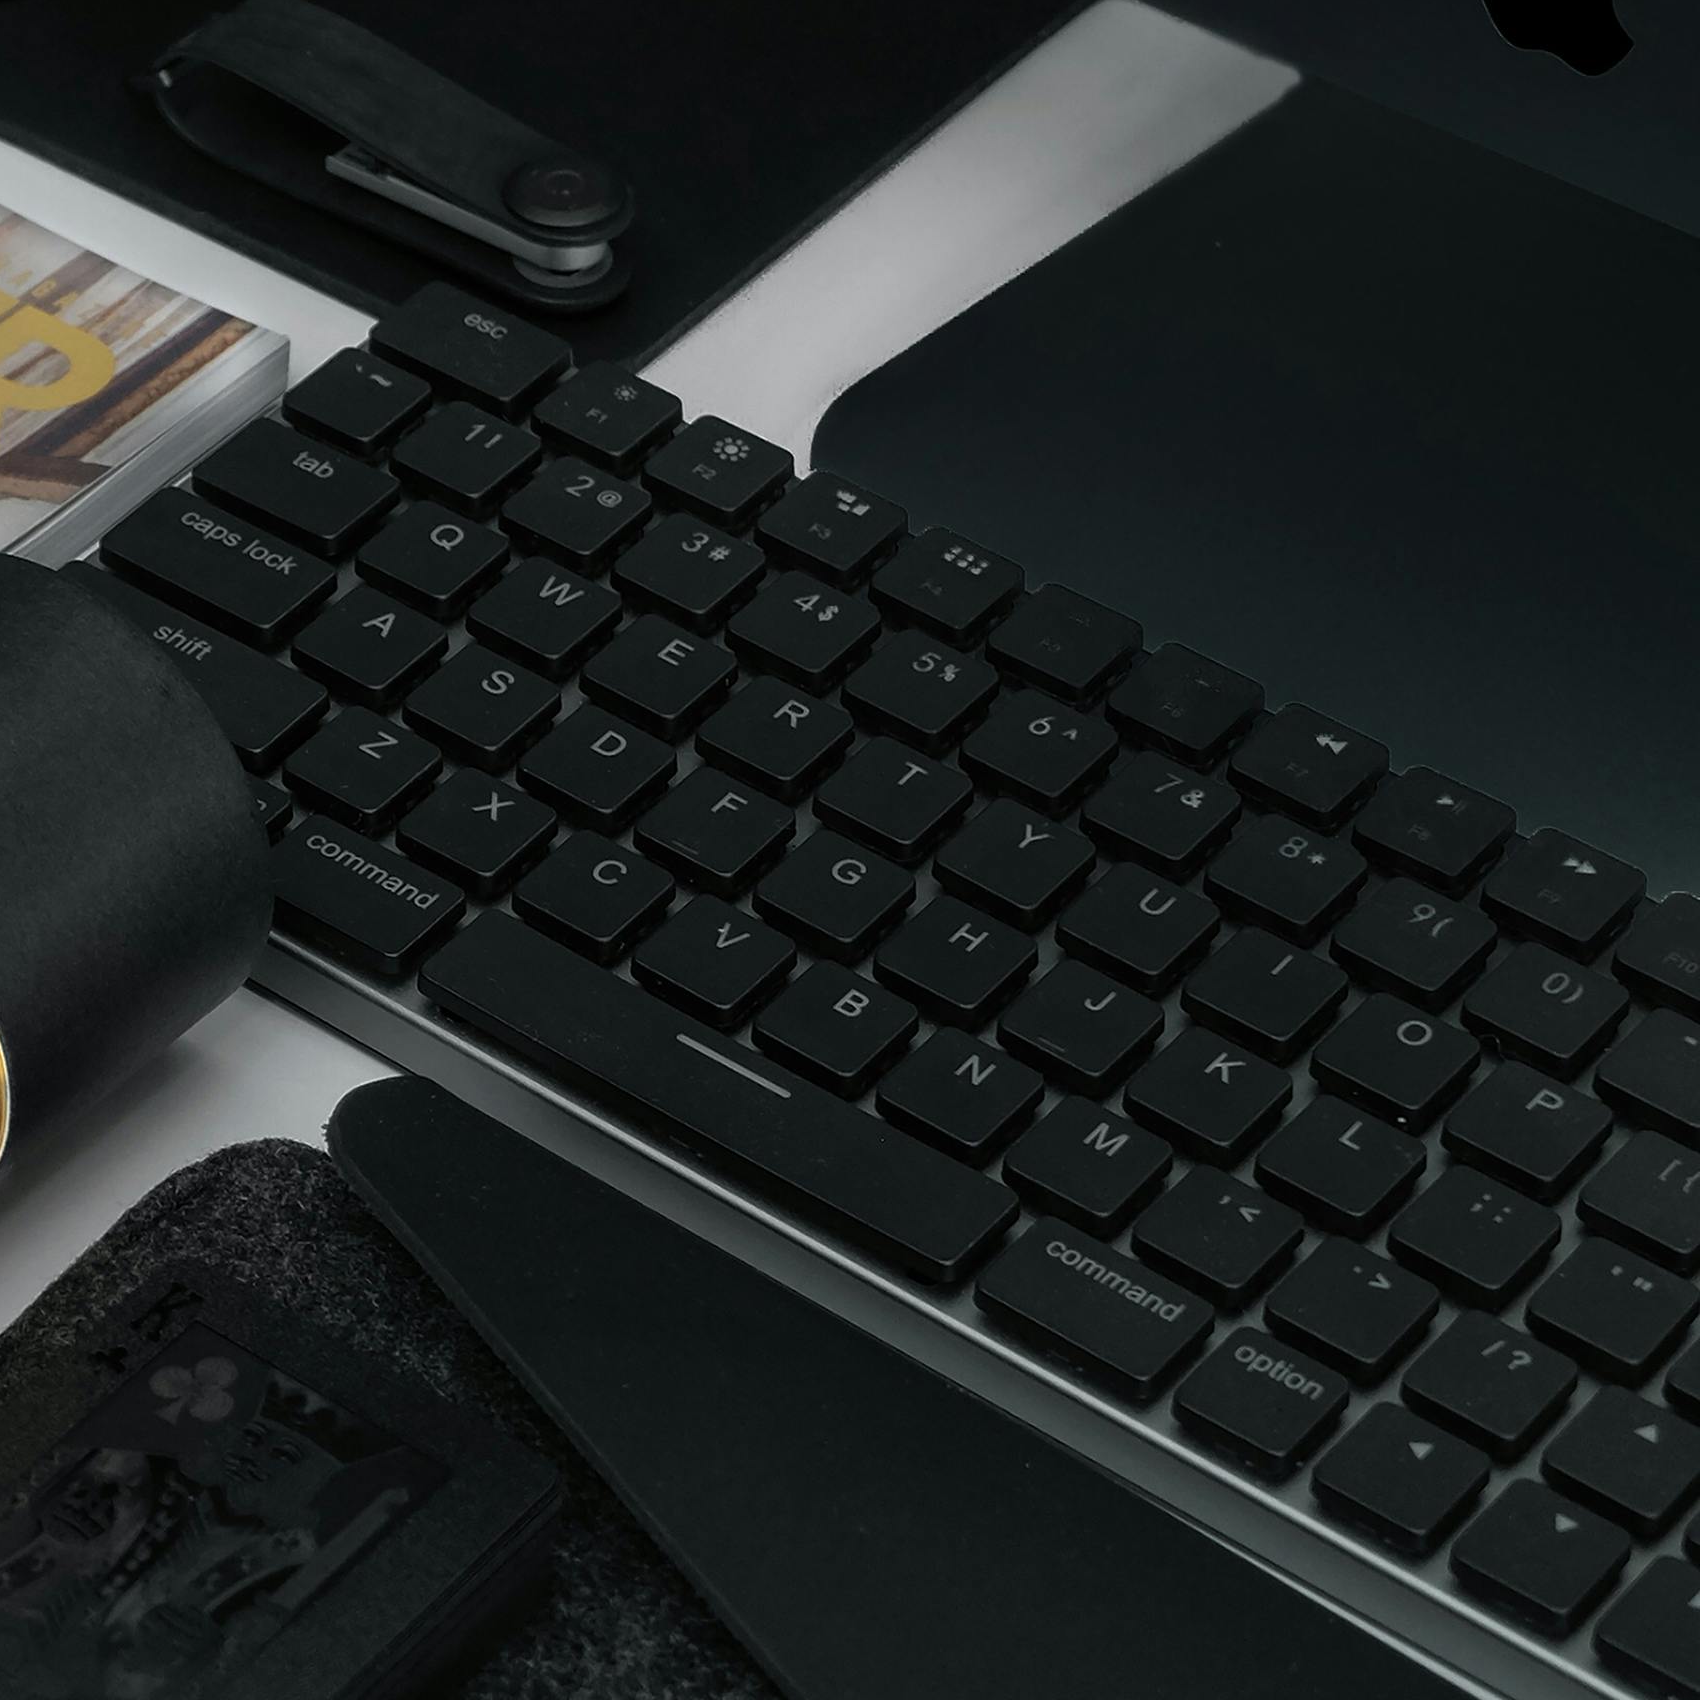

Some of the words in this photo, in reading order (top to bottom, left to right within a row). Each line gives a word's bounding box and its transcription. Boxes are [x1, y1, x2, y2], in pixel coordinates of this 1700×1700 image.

[464, 314, 507, 338] esc
[465, 425, 485, 441] 1
[293, 452, 334, 478] tab
[692, 463, 718, 481] F2
[566, 476, 595, 497] 2
[181, 512, 241, 546] caps
[243, 540, 296, 574] lock
[431, 525, 464, 550] Q
[682, 533, 709, 552] 3
[540, 576, 584, 605] W
[795, 595, 820, 611] 4
[363, 613, 395, 637] A
[154, 626, 212, 660] shift
[658, 639, 694, 665] E
[913, 653, 941, 672] 5
[482, 671, 514, 694] S
[774, 700, 809, 727] R
[1029, 717, 1052, 735] 6
[359, 732, 398, 758] Z
[591, 731, 626, 756] D
[898, 762, 927, 785] T
[1155, 774, 1183, 793] 7
[473, 792, 514, 821] X
[712, 792, 747, 812] F
[1019, 824, 1049, 848] Y
[1279, 837, 1308, 858] 8
[307, 835, 439, 909] command
[593, 860, 627, 884] C
[832, 859, 866, 884] G
[1140, 889, 1176, 914] U
[1410, 904, 1436, 922] 9
[717, 923, 750, 948] V
[949, 923, 988, 951] H
[1272, 955, 1293, 974] I
[834, 989, 869, 1016] B
[1085, 992, 1116, 1010] J
[1397, 1021, 1432, 1045] O
[955, 1055, 996, 1085] N
[1205, 1053, 1245, 1083] K
[1526, 1089, 1564, 1110] P
[1084, 1123, 1129, 1156] M
[1339, 1122, 1362, 1150] L
[1046, 1235, 1185, 1321] command
[1235, 1346, 1323, 1399] option
